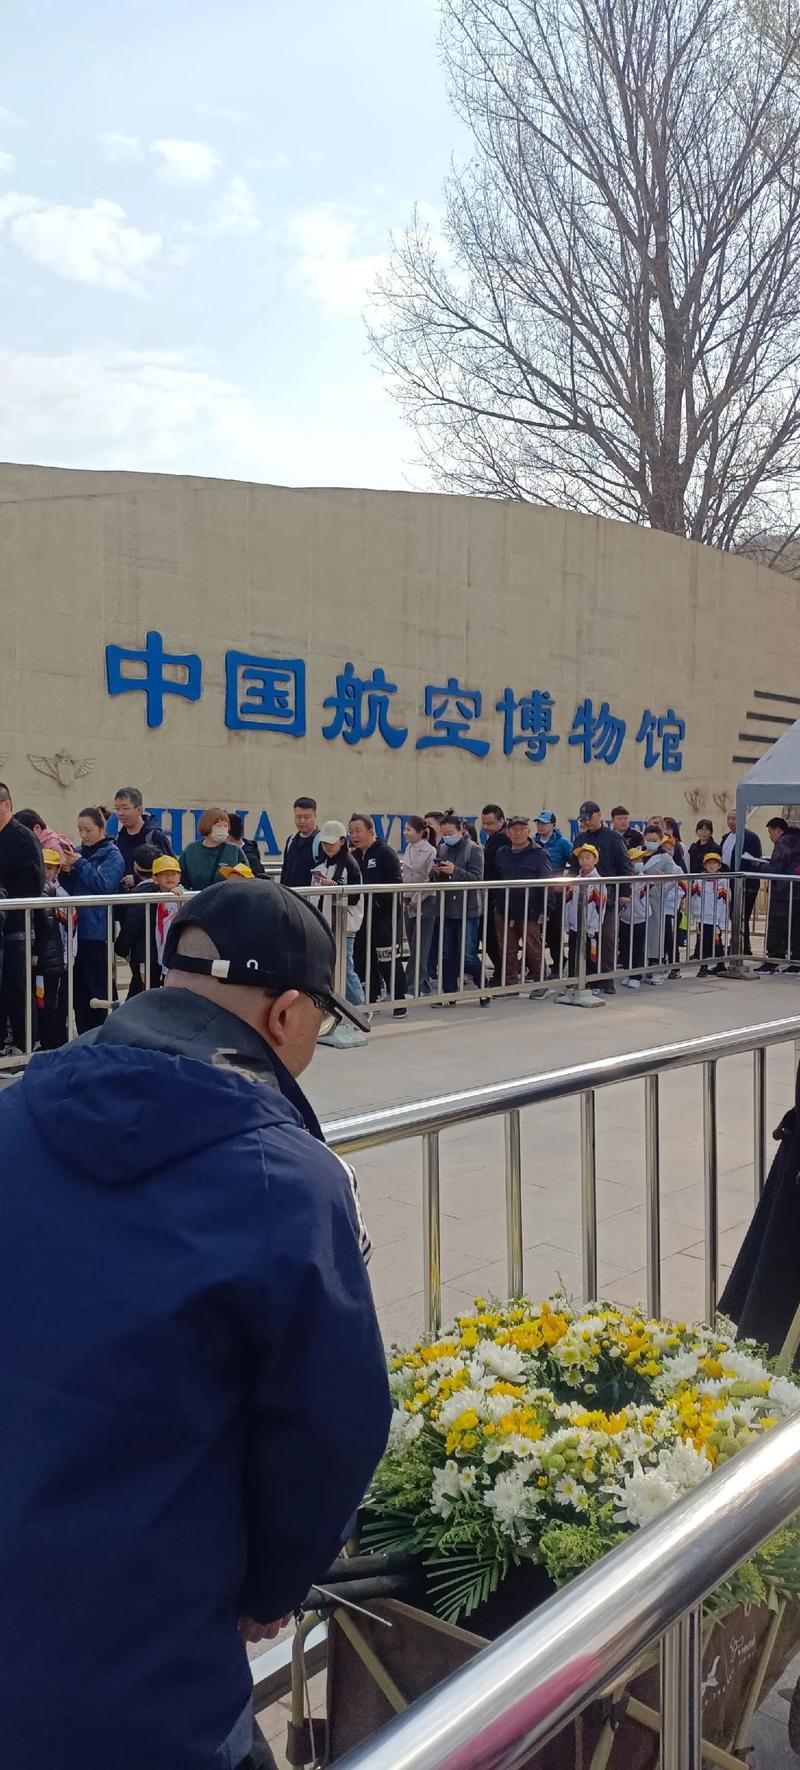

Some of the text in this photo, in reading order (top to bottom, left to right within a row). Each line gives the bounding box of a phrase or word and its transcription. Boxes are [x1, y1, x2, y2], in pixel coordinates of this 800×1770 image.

[105, 630, 686, 772] 中国航空博物馆
